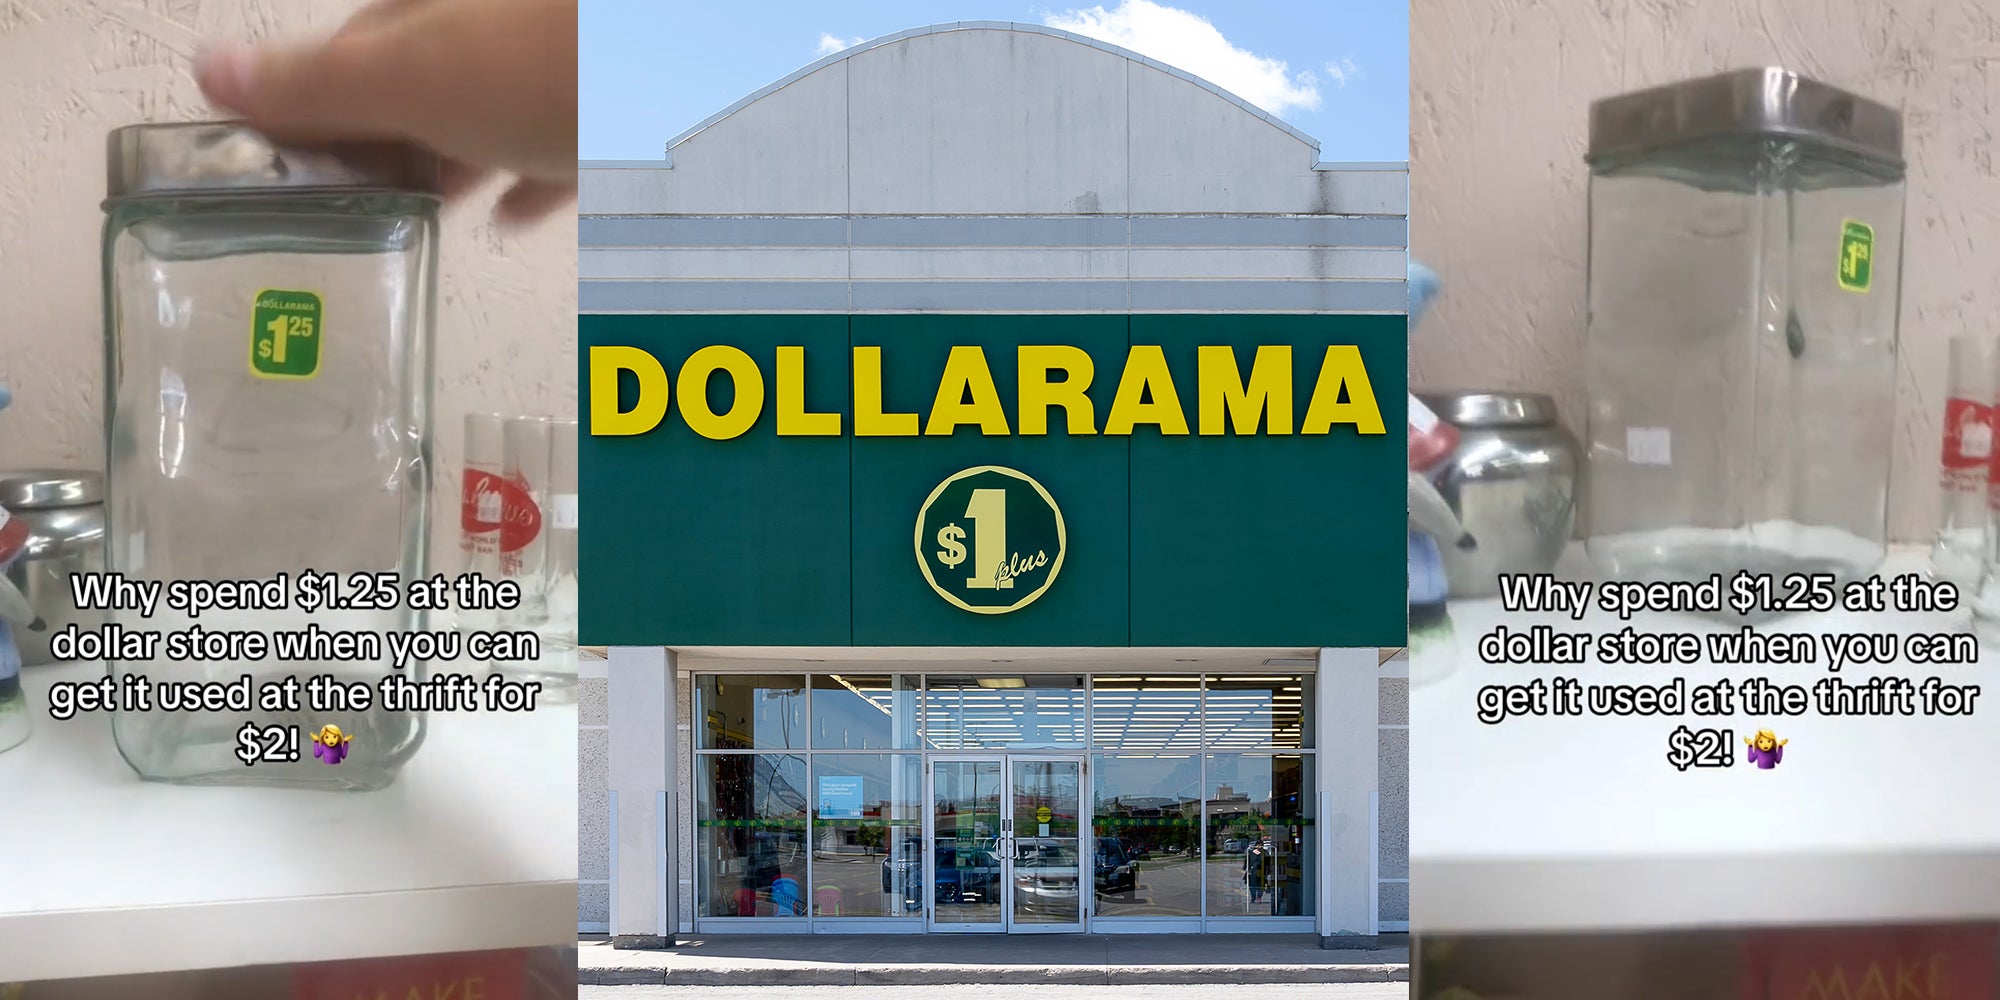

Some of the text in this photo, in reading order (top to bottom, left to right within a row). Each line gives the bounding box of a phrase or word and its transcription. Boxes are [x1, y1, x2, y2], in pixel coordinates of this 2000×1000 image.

[589, 345, 1387, 440] DOLLARAMA
[937, 488, 1014, 589] $1
[994, 549, 1049, 591] plus
